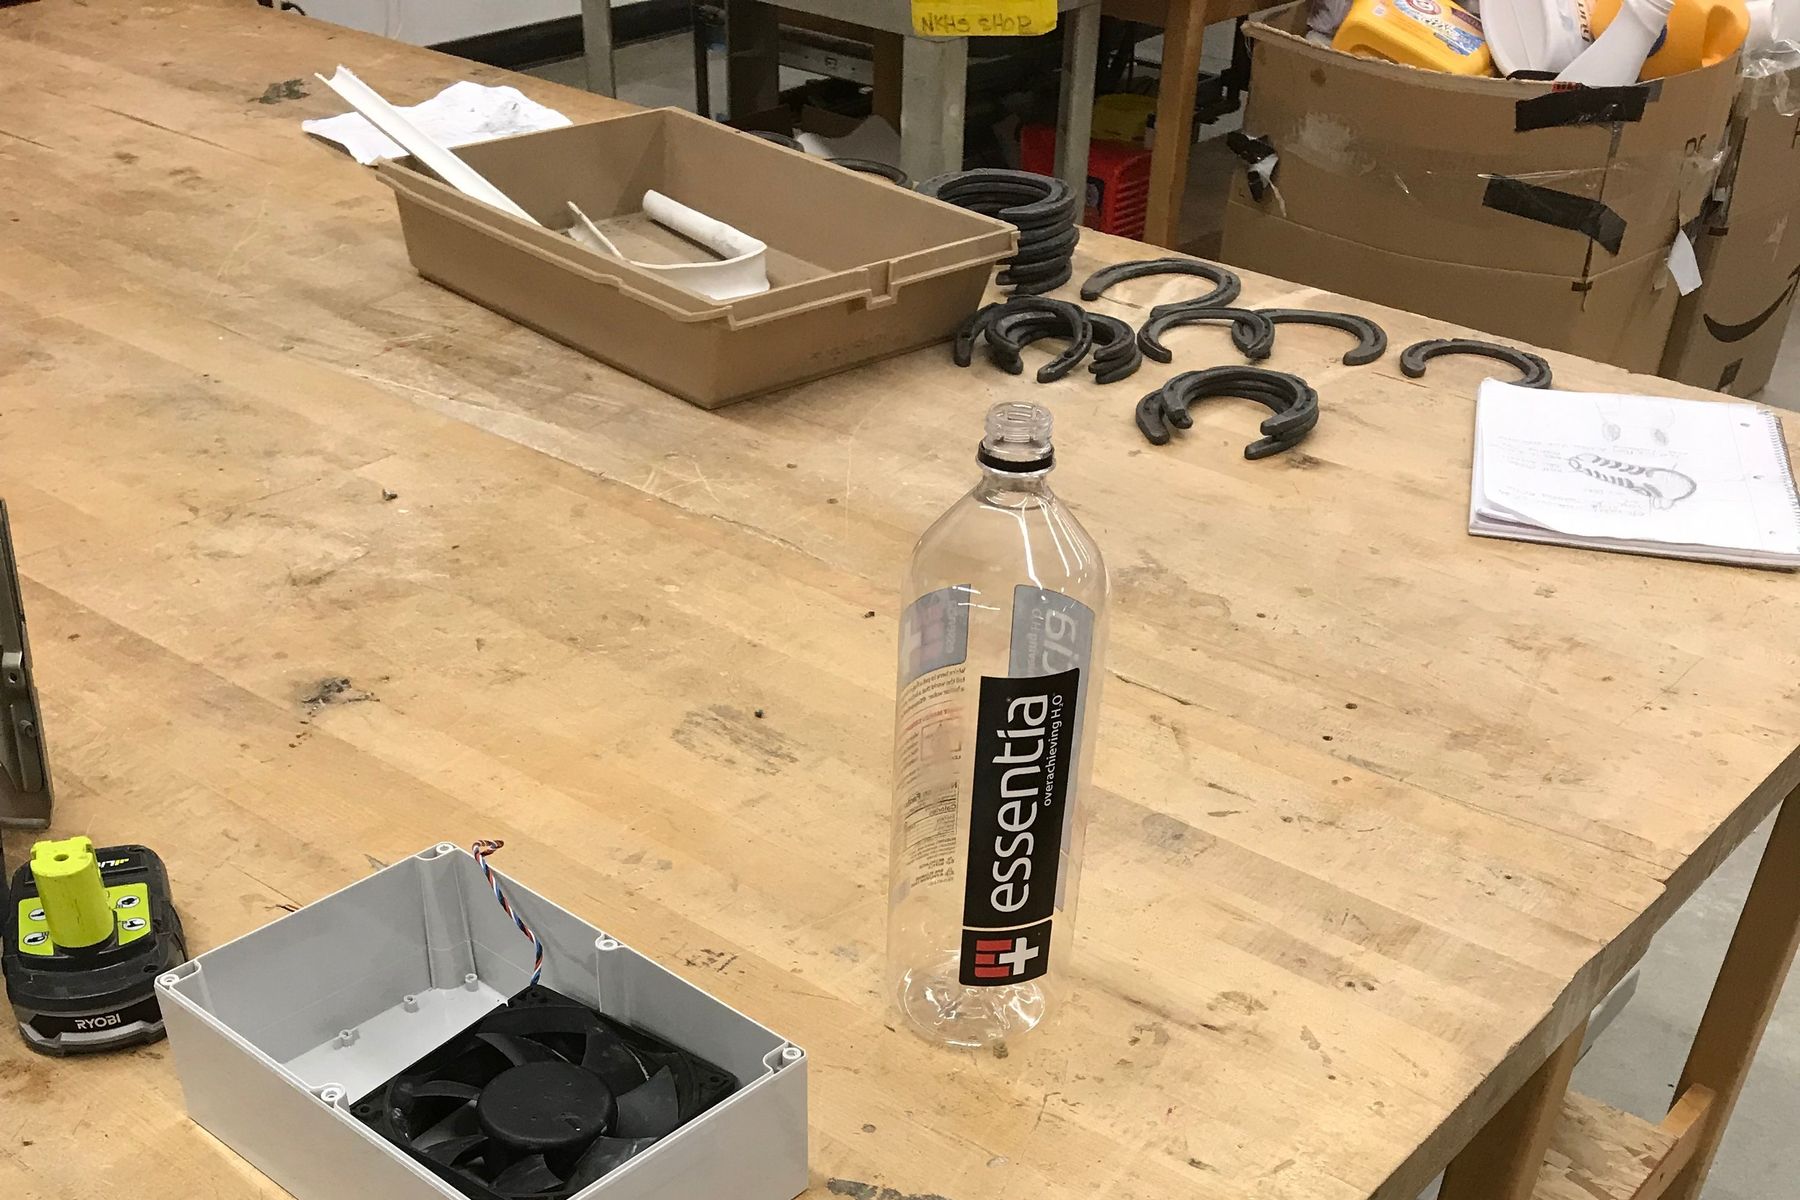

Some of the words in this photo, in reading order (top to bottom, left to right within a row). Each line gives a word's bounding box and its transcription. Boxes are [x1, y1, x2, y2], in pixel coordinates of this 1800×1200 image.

[978, 13, 1032, 34] SHOP
[1043, 720, 1063, 807] overachieving
[990, 694, 1048, 912] essentia
[75, 1013, 121, 1030] RYOBI
